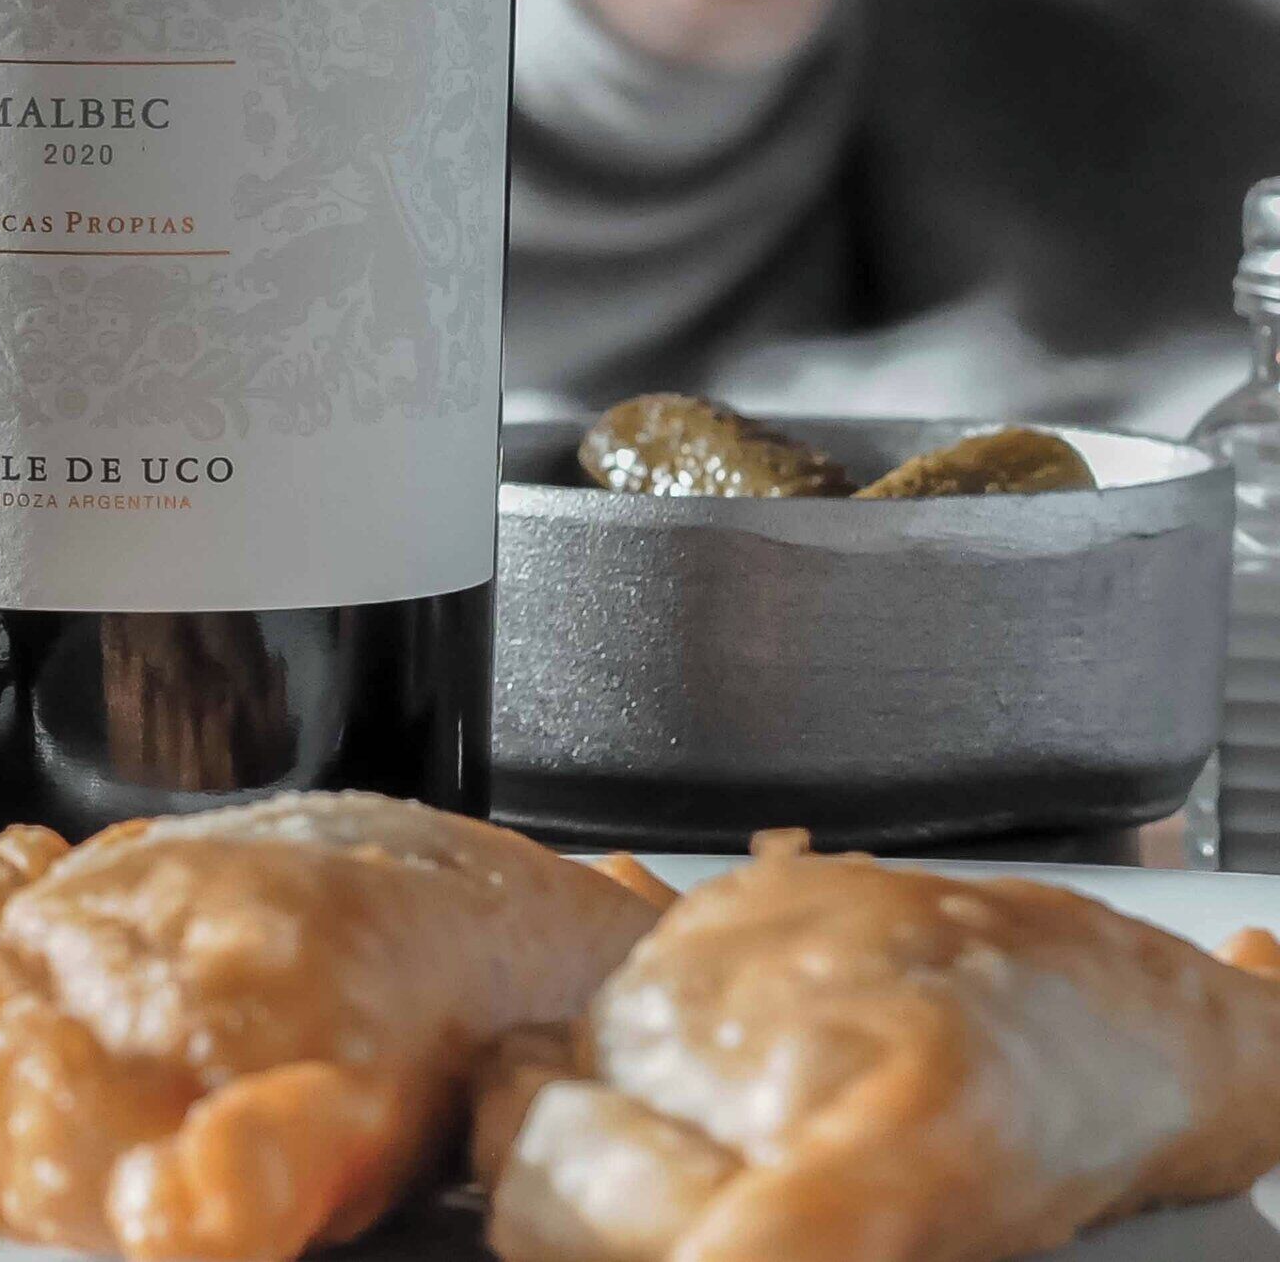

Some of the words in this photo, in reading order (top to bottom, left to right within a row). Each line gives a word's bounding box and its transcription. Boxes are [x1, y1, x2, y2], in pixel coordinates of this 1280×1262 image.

[43, 143, 114, 166] 2020
[64, 211, 196, 235] PROPIAS
[64, 456, 123, 484] DE
[141, 456, 236, 485] UCO
[68, 493, 193, 511] ARGENTINA
